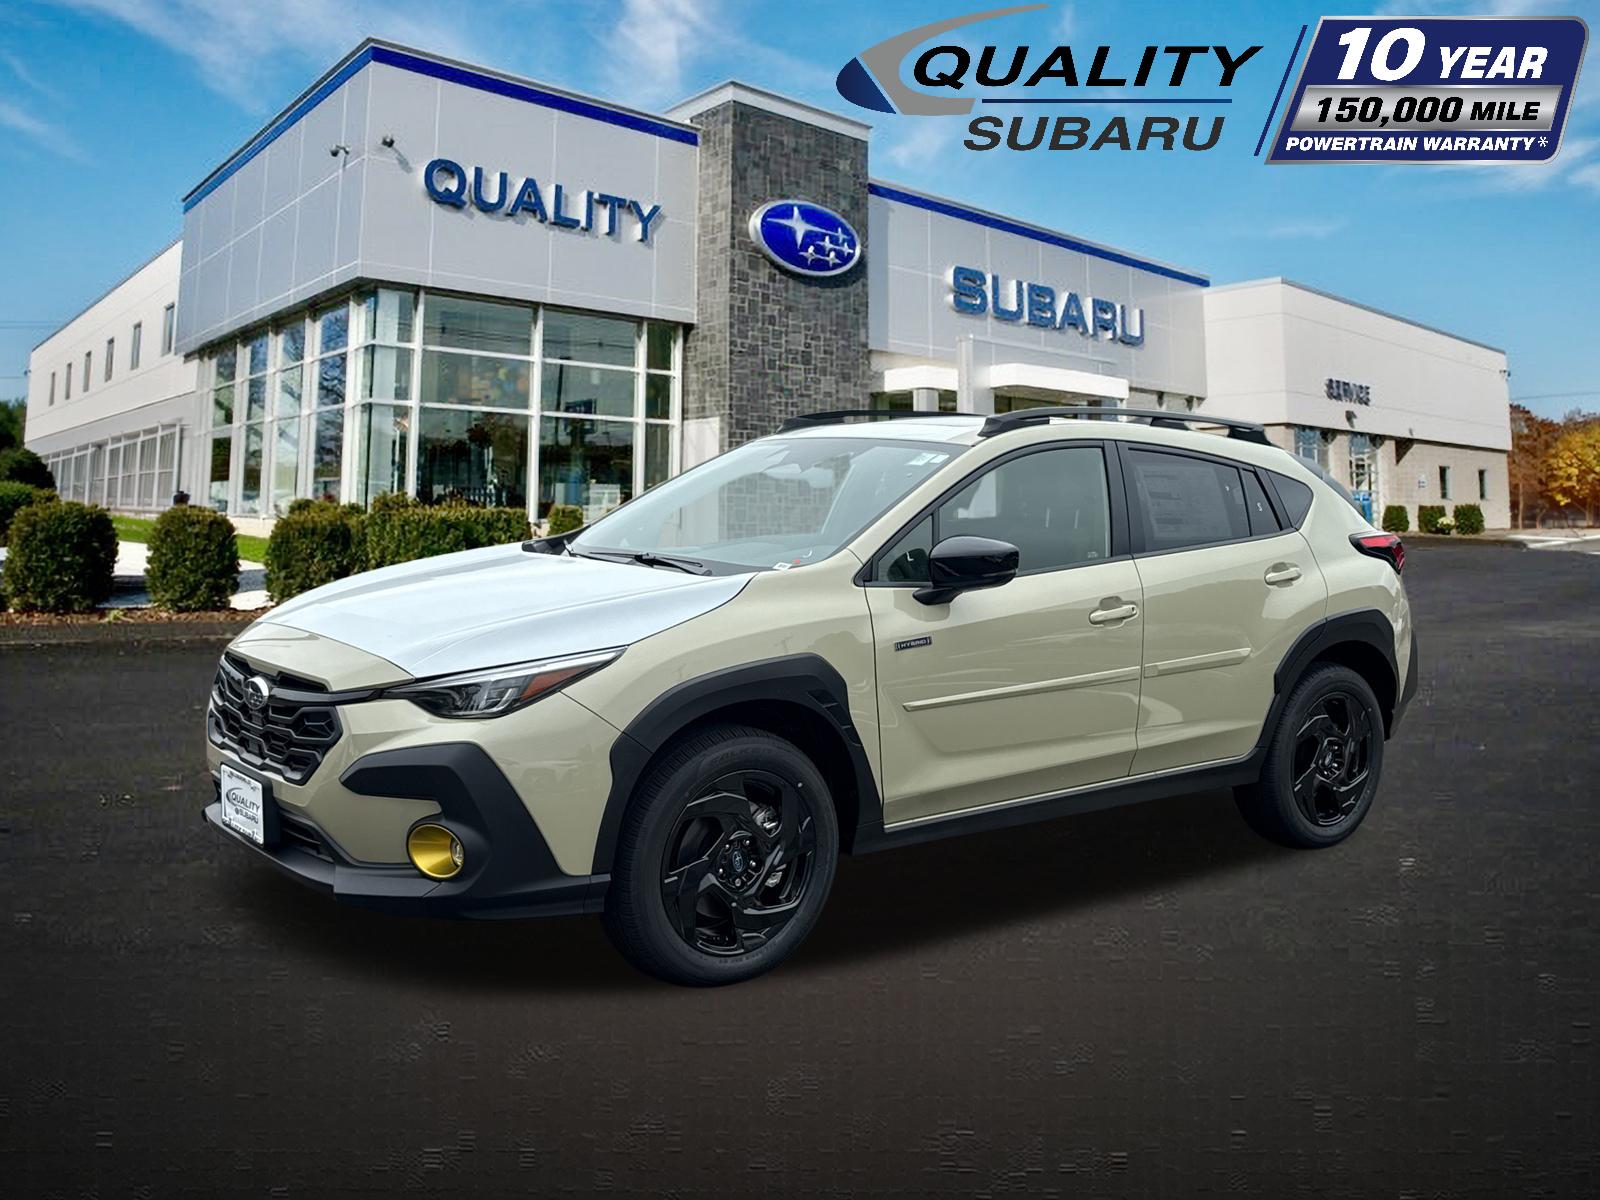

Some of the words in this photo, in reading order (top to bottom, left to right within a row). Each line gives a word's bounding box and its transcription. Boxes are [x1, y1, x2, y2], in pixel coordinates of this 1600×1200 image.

[424, 157, 662, 243] QUALITY
[950, 265, 1146, 347] SUBARU
[231, 791, 261, 813] QUALITY
